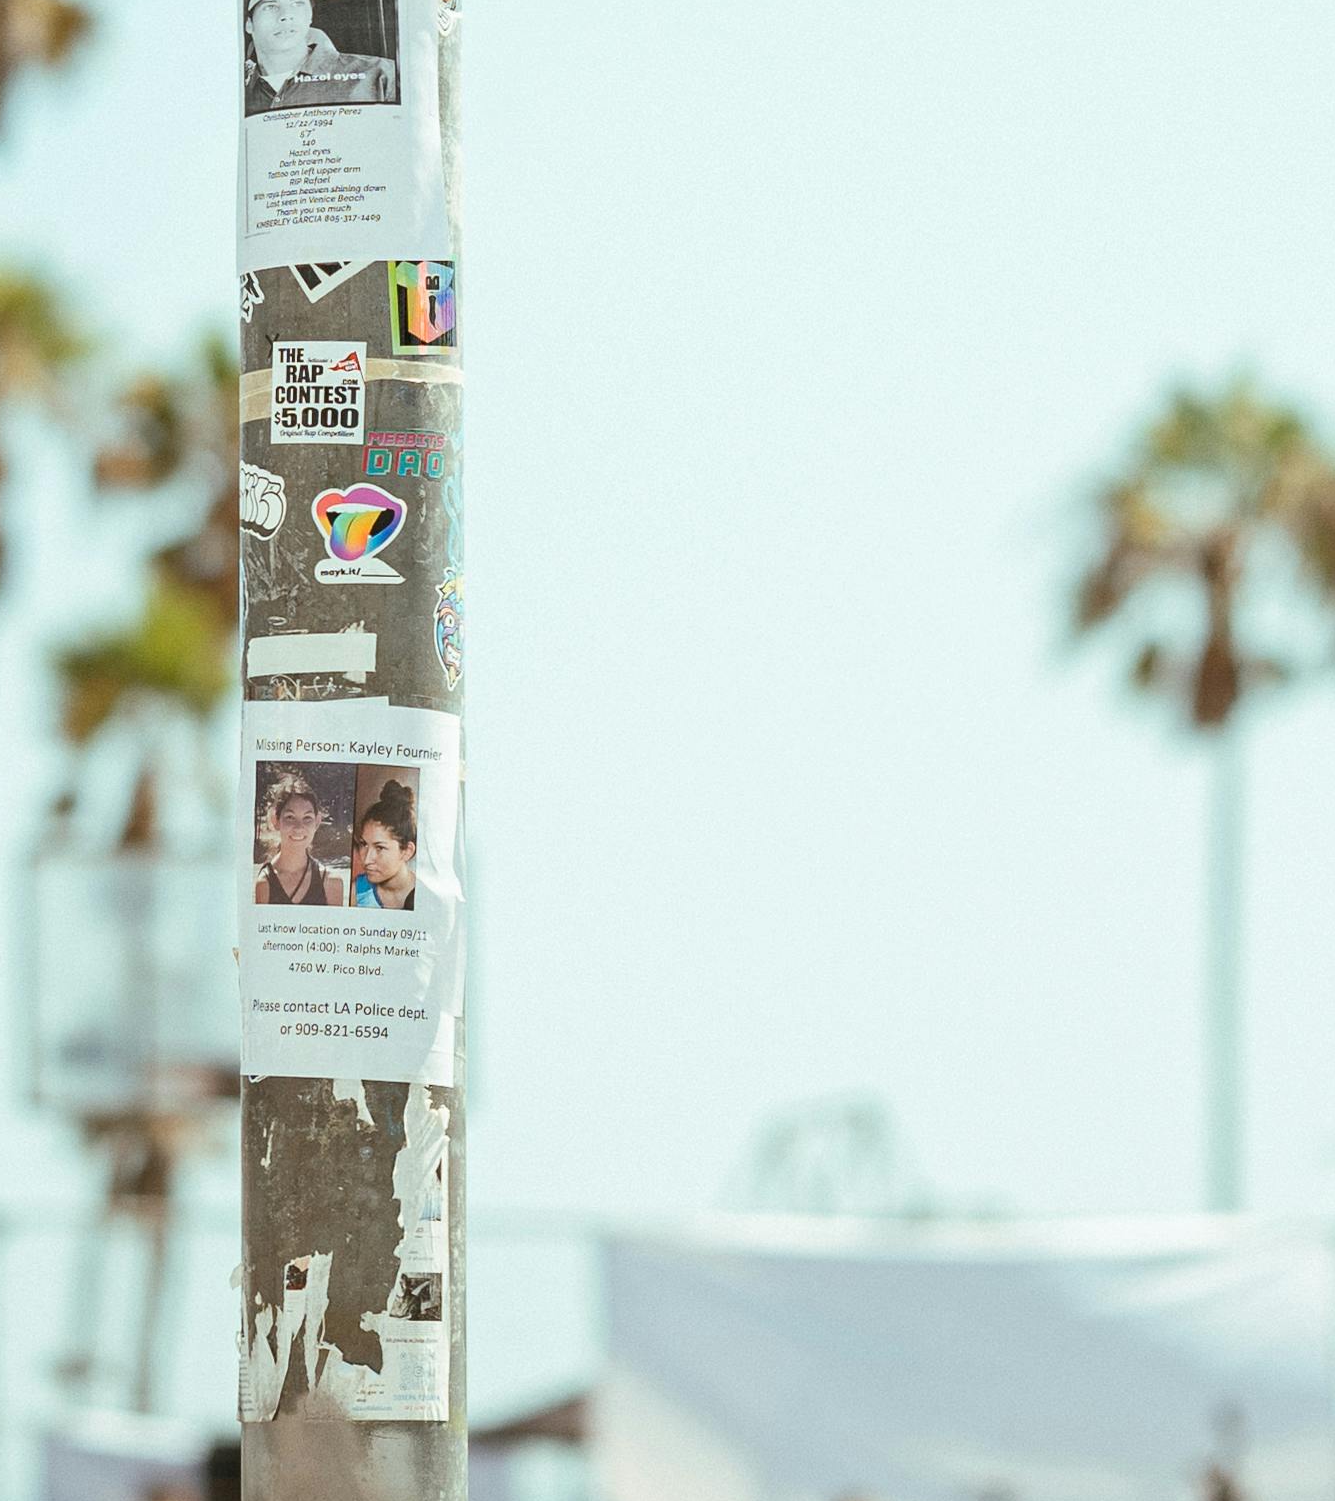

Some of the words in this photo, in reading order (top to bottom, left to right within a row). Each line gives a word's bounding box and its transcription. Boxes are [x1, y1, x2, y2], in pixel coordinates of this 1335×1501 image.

[294, 72, 331, 83] Hazel
[333, 71, 366, 82] eyes
[303, 108, 337, 118] Anthony
[338, 107, 362, 115] Perez
[289, 148, 311, 157] Hazel
[312, 148, 331, 156] eyes
[279, 159, 296, 168] Dark
[298, 157, 323, 167] brown
[324, 156, 342, 164] hair
[301, 167, 315, 177] left
[316, 167, 342, 177] upper
[343, 165, 361, 173] arm
[299, 187, 329, 196] heaven
[331, 184, 362, 194] shining
[363, 183, 387, 192] down
[266, 200, 281, 209] Last
[309, 195, 336, 204] Venice
[338, 194, 366, 203] Beach
[276, 208, 299, 217] Thank
[300, 208, 315, 217] you
[328, 204, 352, 213] much
[293, 215, 323, 225] GARCIA
[278, 348, 304, 363] THE
[286, 364, 324, 383] RAP
[275, 385, 361, 405] CONTEST
[274, 407, 359, 430] $5,000
[367, 432, 446, 448] MEEBITS
[362, 446, 445, 478] DAO
[256, 738, 292, 753] Missing
[296, 739, 345, 753] Person:
[349, 741, 393, 758] Kayley
[396, 744, 443, 761] Fournier
[258, 923, 272, 934] Last
[273, 923, 296, 934] know
[299, 924, 340, 936] location
[343, 927, 357, 936] on
[360, 926, 398, 941] Sunday
[400, 929, 427, 942] 09/11
[262, 941, 304, 952] afternoon
[306, 942, 340, 955] (4:00):
[346, 943, 381, 957] Ralphs
[384, 945, 420, 958] Market
[288, 962, 313, 973] 4760
[315, 963, 329, 974] W.
[333, 964, 355, 975] Pico
[358, 965, 384, 976] Blvd.
[252, 999, 281, 1013] Please
[283, 1001, 330, 1014] contact
[334, 1002, 351, 1015] LA
[355, 1003, 395, 1018] Police
[398, 1005, 429, 1021] dept.
[280, 1026, 292, 1036] or
[295, 1023, 389, 1039] 909-821-6594
